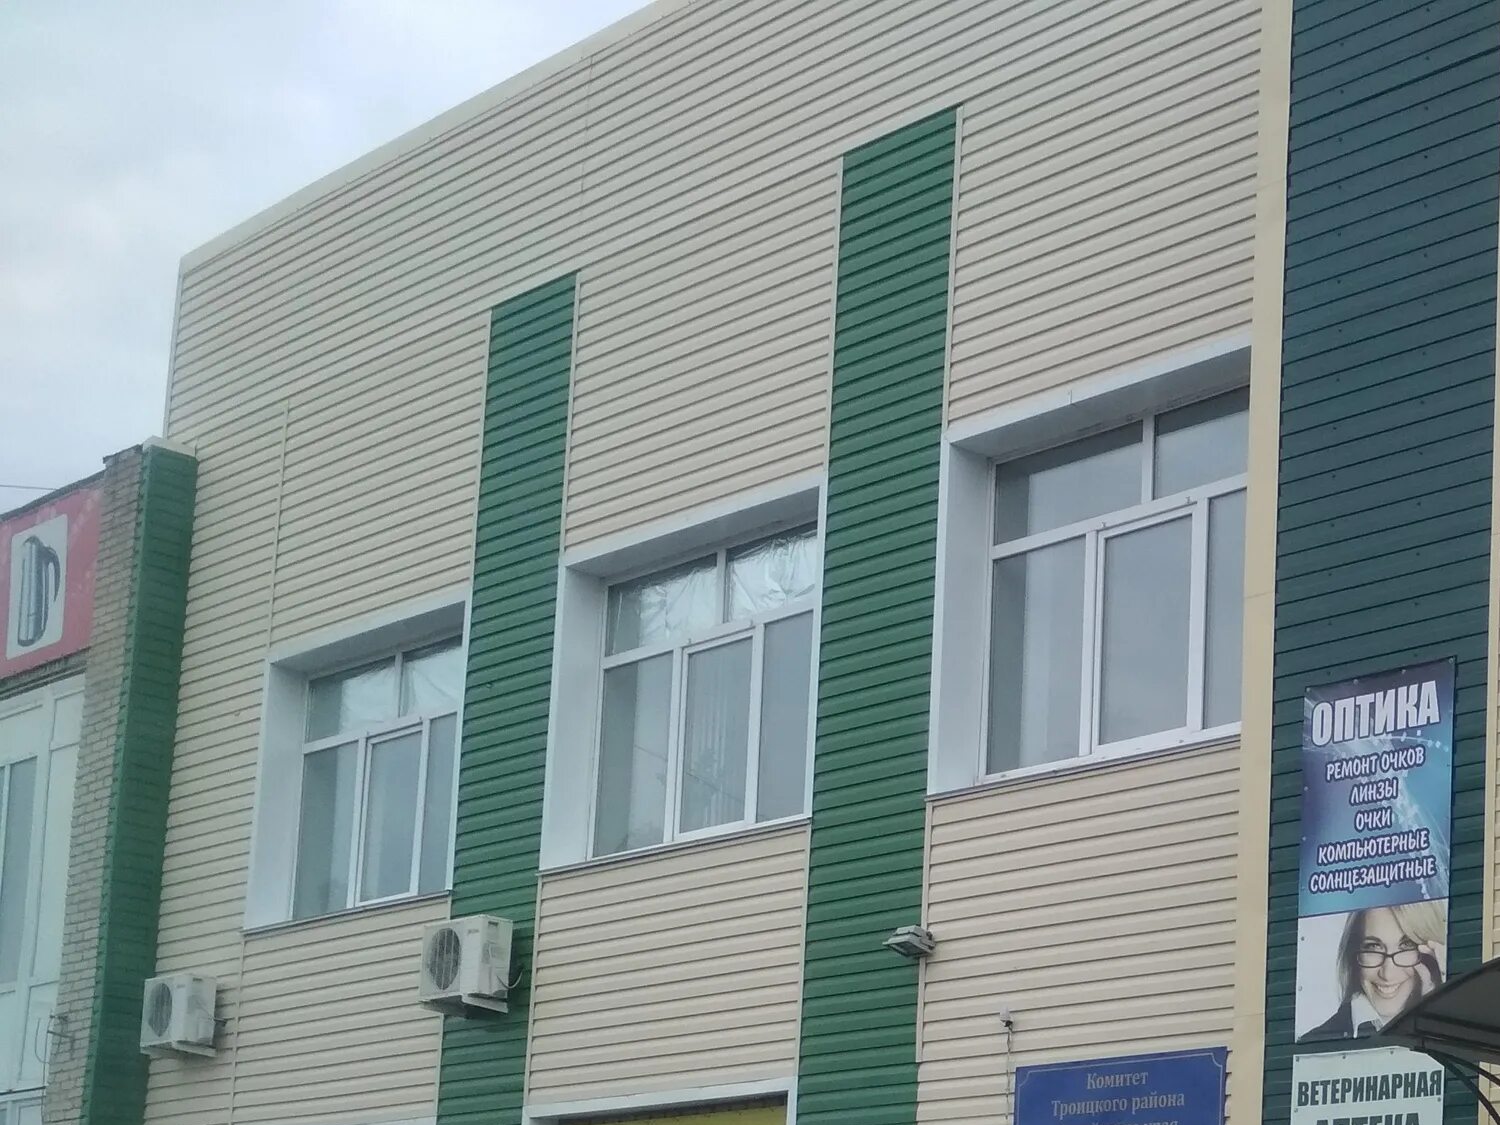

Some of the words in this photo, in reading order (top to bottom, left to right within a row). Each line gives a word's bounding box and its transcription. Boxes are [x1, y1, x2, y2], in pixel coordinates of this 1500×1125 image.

[1312, 680, 1441, 746] ОПТИКА
[1326, 755, 1380, 781] РЕМОНТ
[1380, 747, 1425, 771] ОЧКОВ
[1350, 779, 1398, 804] ЛИНЗЫ
[1355, 808, 1391, 831] ОЧКИ
[1317, 830, 1429, 864] КОМПЬЮТЕРНЫЕ
[1309, 857, 1436, 893] СОЛНЦЕЗАЩИТНЫЕ
[1086, 1071, 1149, 1090] Комитет
[1297, 1069, 1442, 1107] ВЕТЕРИНАРНАЯ
[1051, 1098, 1127, 1121] Троицкого
[1132, 1091, 1185, 1114] района
